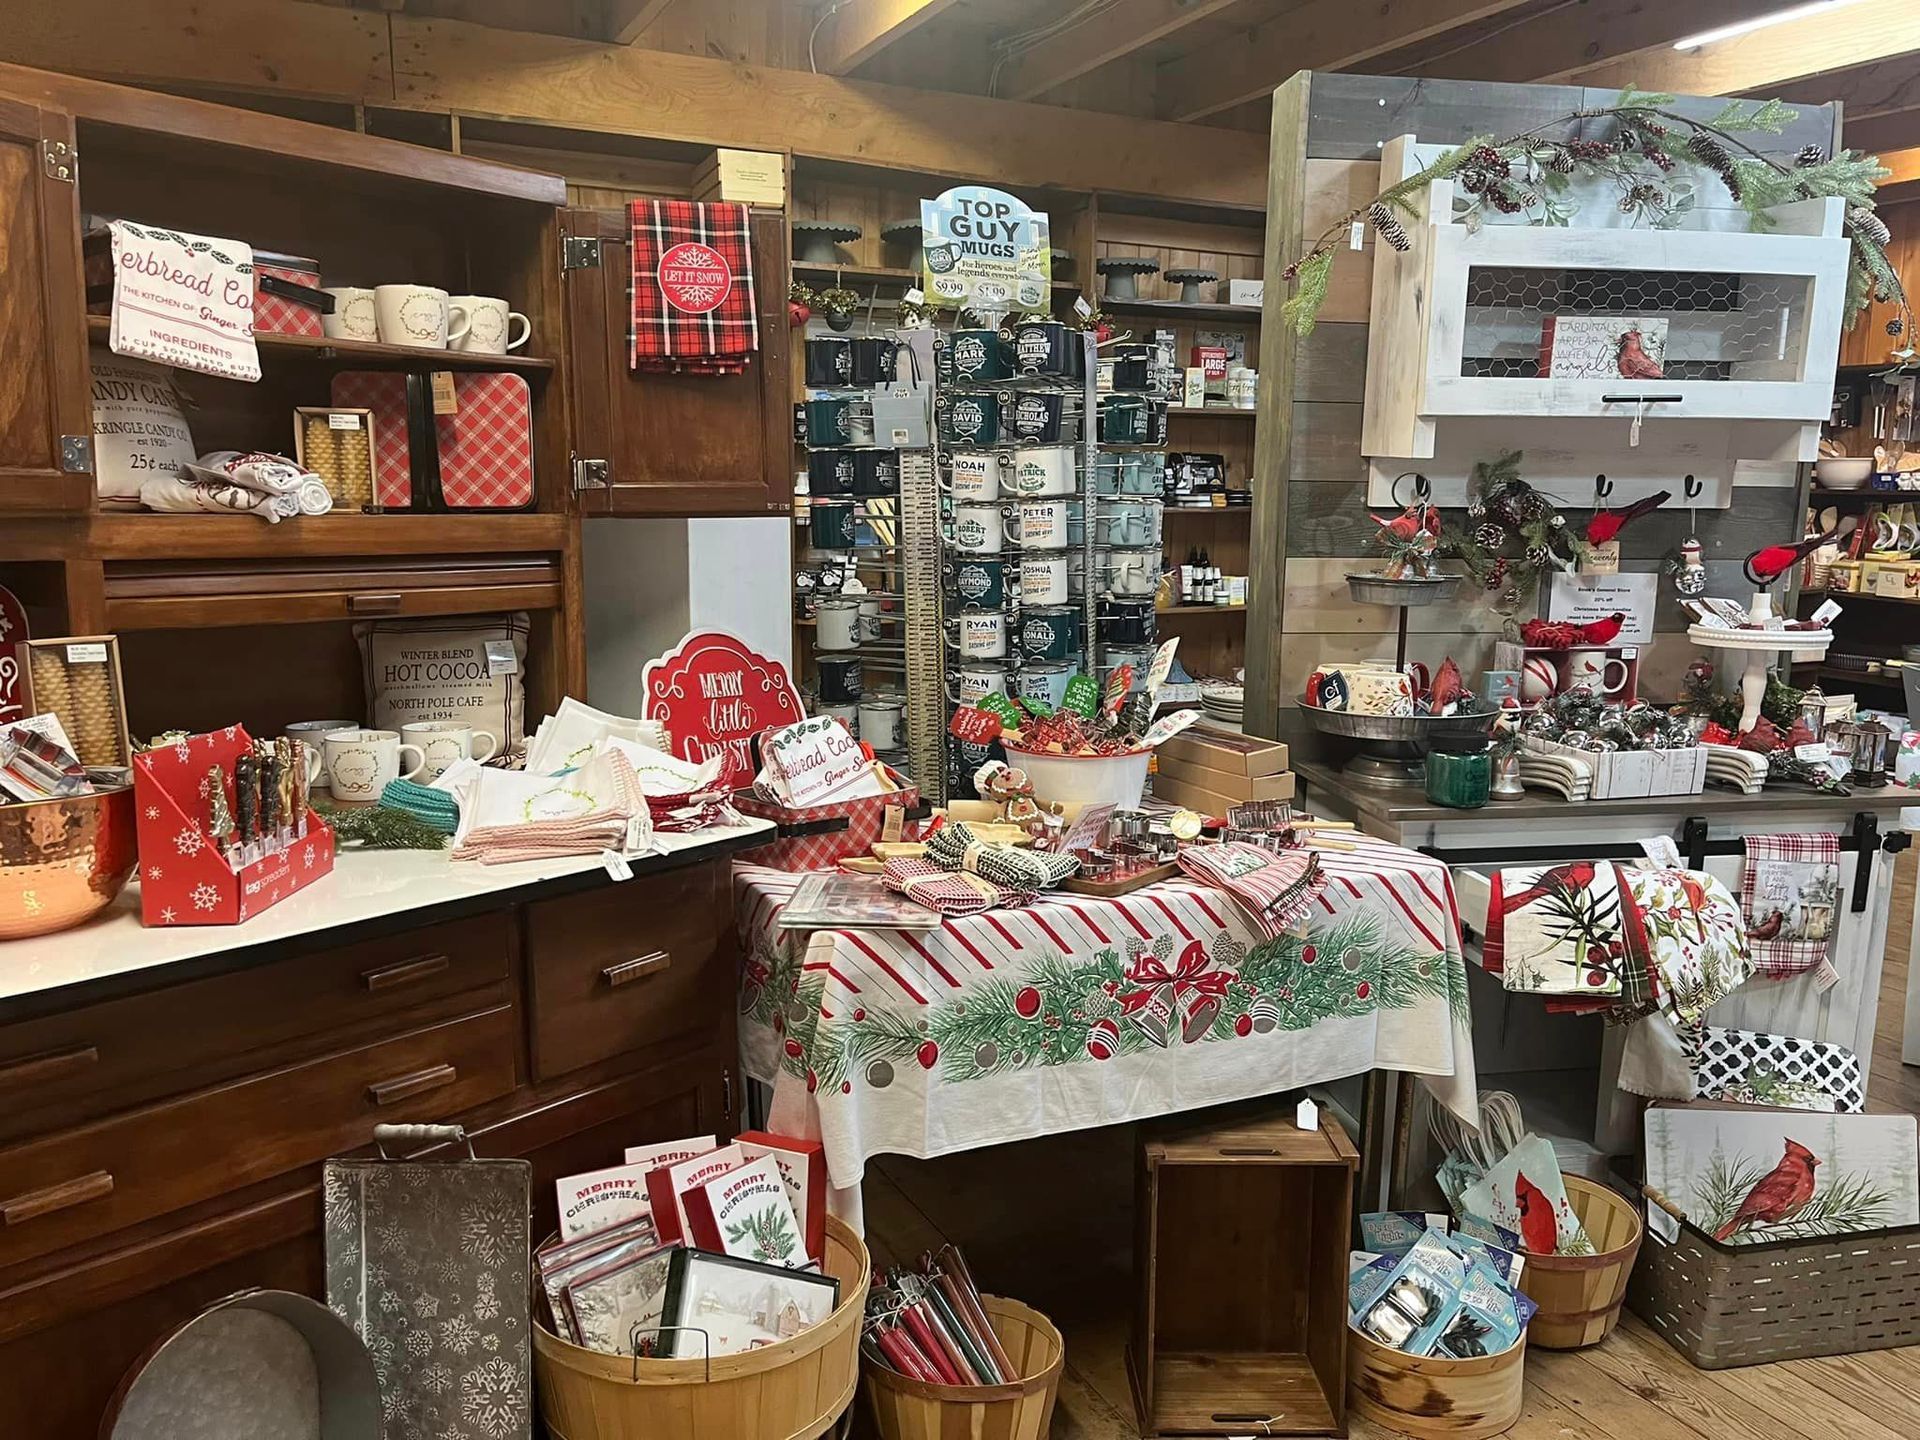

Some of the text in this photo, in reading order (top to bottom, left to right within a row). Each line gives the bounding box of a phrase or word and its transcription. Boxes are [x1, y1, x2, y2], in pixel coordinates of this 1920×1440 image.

[958, 199, 1011, 219] TOP
[949, 215, 1020, 242] GUY
[961, 241, 1015, 258] MUGS
[957, 268, 990, 278] legends
[962, 260, 974, 269] For
[975, 260, 1002, 271] heroes
[1004, 265, 1017, 273] and
[121, 251, 213, 297] erbread
[664, 270, 725, 284] LET IT SNOW
[935, 281, 964, 294] $9.99
[123, 285, 140, 297] THE
[142, 291, 181, 308] KITCHEN
[199, 306, 239, 330] Ginger
[1559, 322, 1619, 332] CARDINALS
[149, 329, 233, 360] INGREDIENTS
[1558, 336, 1599, 345] APPEAR
[955, 350, 985, 361] MARK
[1555, 344, 1616, 378] angels
[1557, 350, 1591, 360] WHEN
[1201, 358, 1226, 370] LARGE
[952, 414, 982, 423] DAVID
[93, 422, 145, 434] KRINGLE
[146, 423, 175, 437] CANDY
[130, 453, 180, 471] 25¢ each
[955, 460, 985, 472] NOAH
[1023, 508, 1054, 518] PETER
[1023, 565, 1052, 575] JOSHUA
[967, 620, 997, 630] RYAN
[400, 650, 440, 660] WINTER
[441, 649, 473, 660] BLEND
[384, 662, 492, 683] HOT COCOA
[698, 670, 744, 699] MERRY
[962, 675, 989, 689] RYAN
[389, 696, 484, 710] NORTH POLE CAFE
[1026, 692, 1050, 701] SAM
[433, 711, 453, 719] 1934
[702, 699, 757, 740] little
[961, 741, 990, 753] SCOTT
[824, 767, 850, 786] Ginger
[245, 881, 260, 896] tag
[686, 1162, 732, 1186] MERRY
[575, 1179, 637, 1200] MERRY
[723, 1173, 767, 1200] MERRY
[566, 1190, 650, 1219] CHRISTMAS
[719, 1184, 780, 1220] CHRISTMAS
